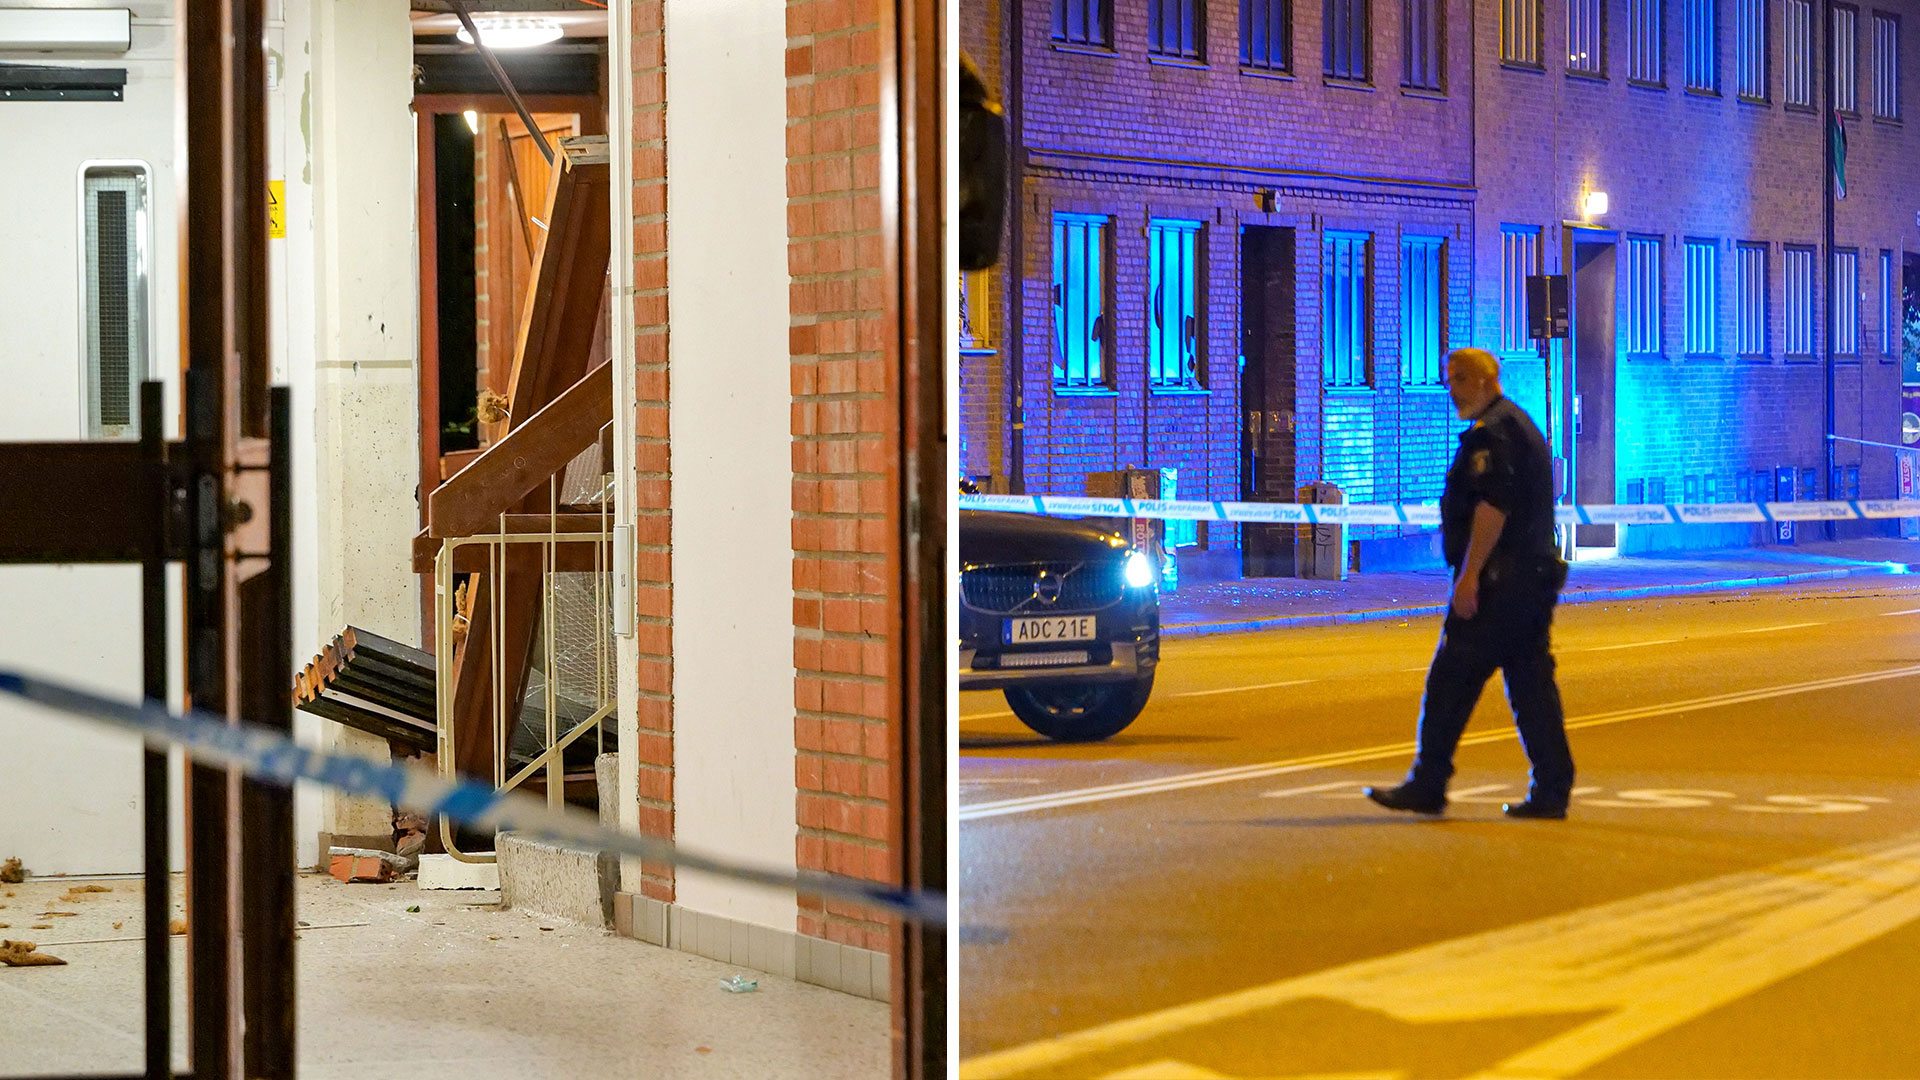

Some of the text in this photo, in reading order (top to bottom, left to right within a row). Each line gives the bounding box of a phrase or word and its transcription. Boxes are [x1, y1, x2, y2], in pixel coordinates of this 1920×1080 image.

[959, 494, 986, 503] POLIS
[1091, 503, 1121, 513] POLIS
[1138, 502, 1167, 511] POLIS
[1272, 509, 1302, 519] POLIS
[1320, 507, 1349, 517] POLIS
[1019, 619, 1089, 640] ADC 21E
